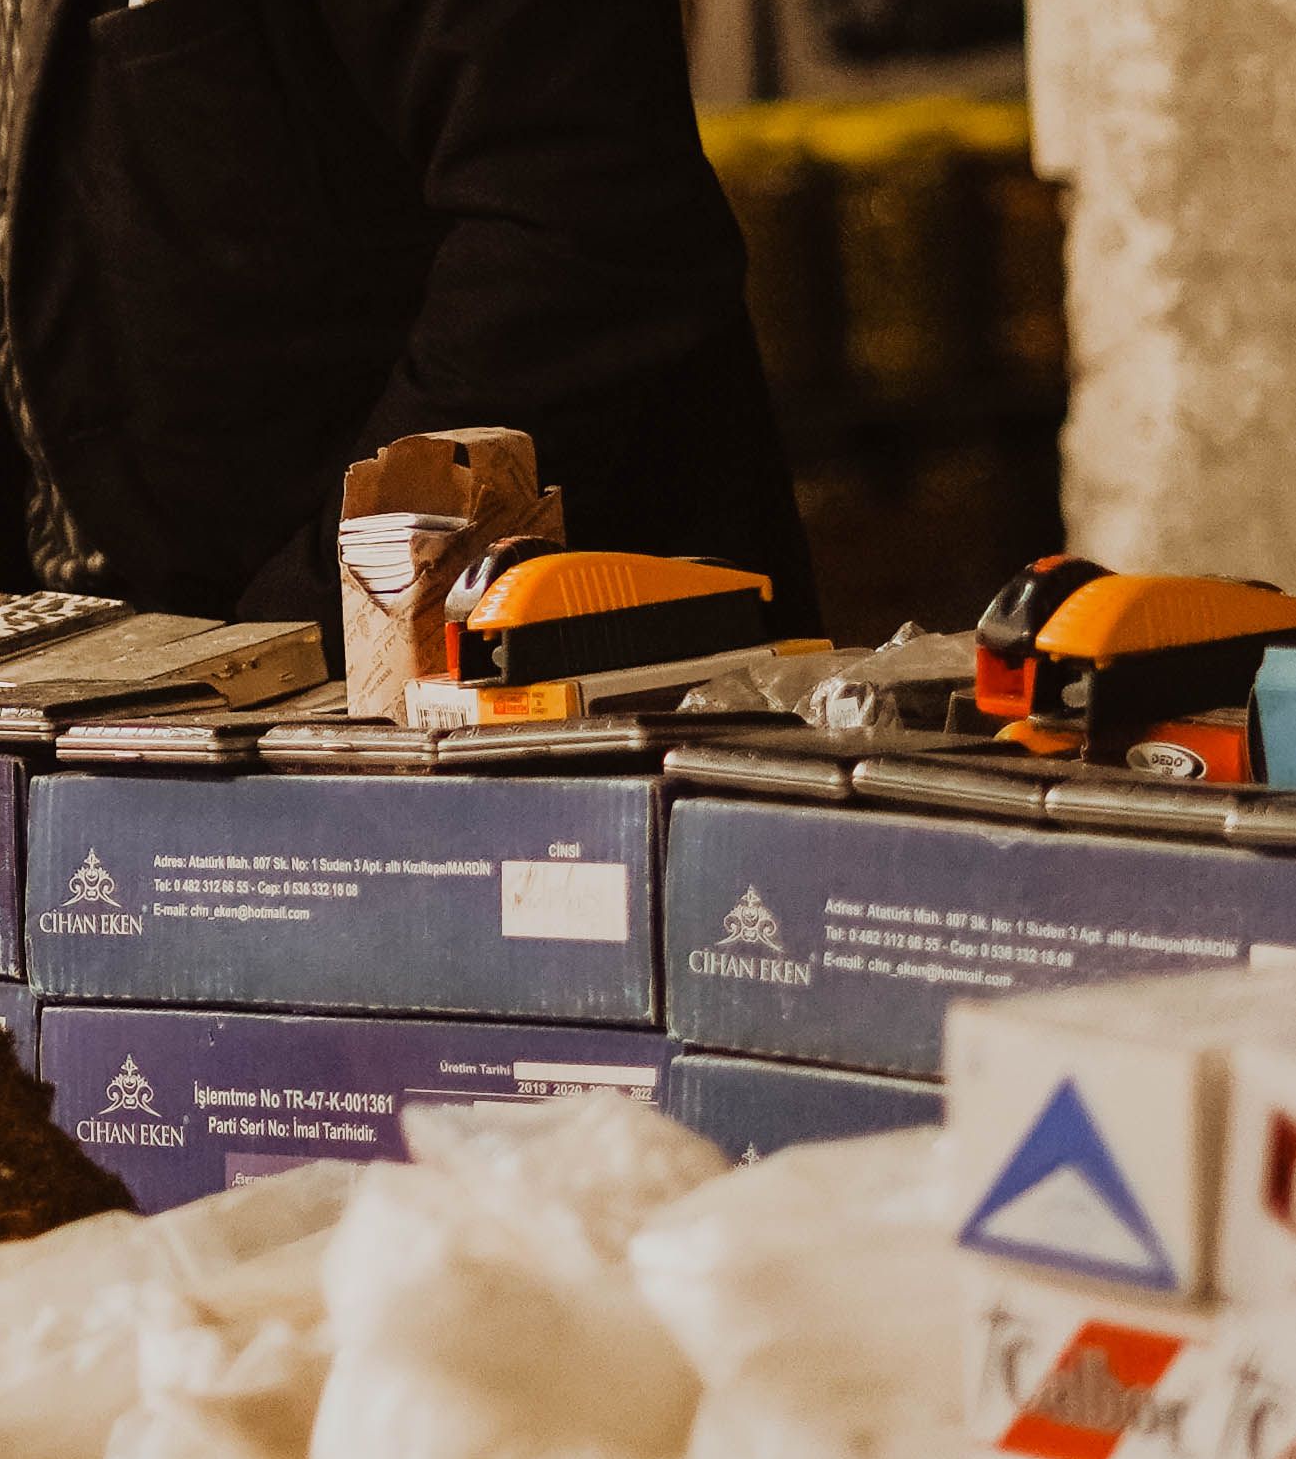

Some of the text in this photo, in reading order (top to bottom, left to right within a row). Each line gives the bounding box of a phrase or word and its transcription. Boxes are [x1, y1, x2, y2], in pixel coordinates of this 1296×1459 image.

[548, 841, 582, 860] CİNSİ
[153, 855, 186, 868] Adres:
[188, 855, 225, 869] Atatürk
[226, 857, 250, 870] Mah.
[291, 858, 309, 872] No:
[361, 861, 383, 875] Apt.
[153, 879, 172, 893] Tel:
[202, 880, 221, 893] 312
[311, 883, 330, 896] 332
[153, 902, 188, 917] E-mail:
[824, 898, 865, 916] Adres:
[913, 907, 943, 926] Mah.
[39, 909, 143, 935] CİHAN EKEN
[824, 925, 845, 941] Tel:
[688, 949, 810, 986] CİHAN EKEN
[823, 952, 865, 970] E-mail:
[440, 1060, 511, 1076] Üretim Tarihi
[194, 1081, 394, 1115] İşlemtme No TR-47-K-001361
[517, 1081, 547, 1095] 2019
[552, 1084, 582, 1096] 2020
[630, 1087, 652, 1101] 2022
[76, 1117, 185, 1147] CİHAN EKEN
[208, 1116, 378, 1143] Parti Seri No: İmal Tarihidir.
